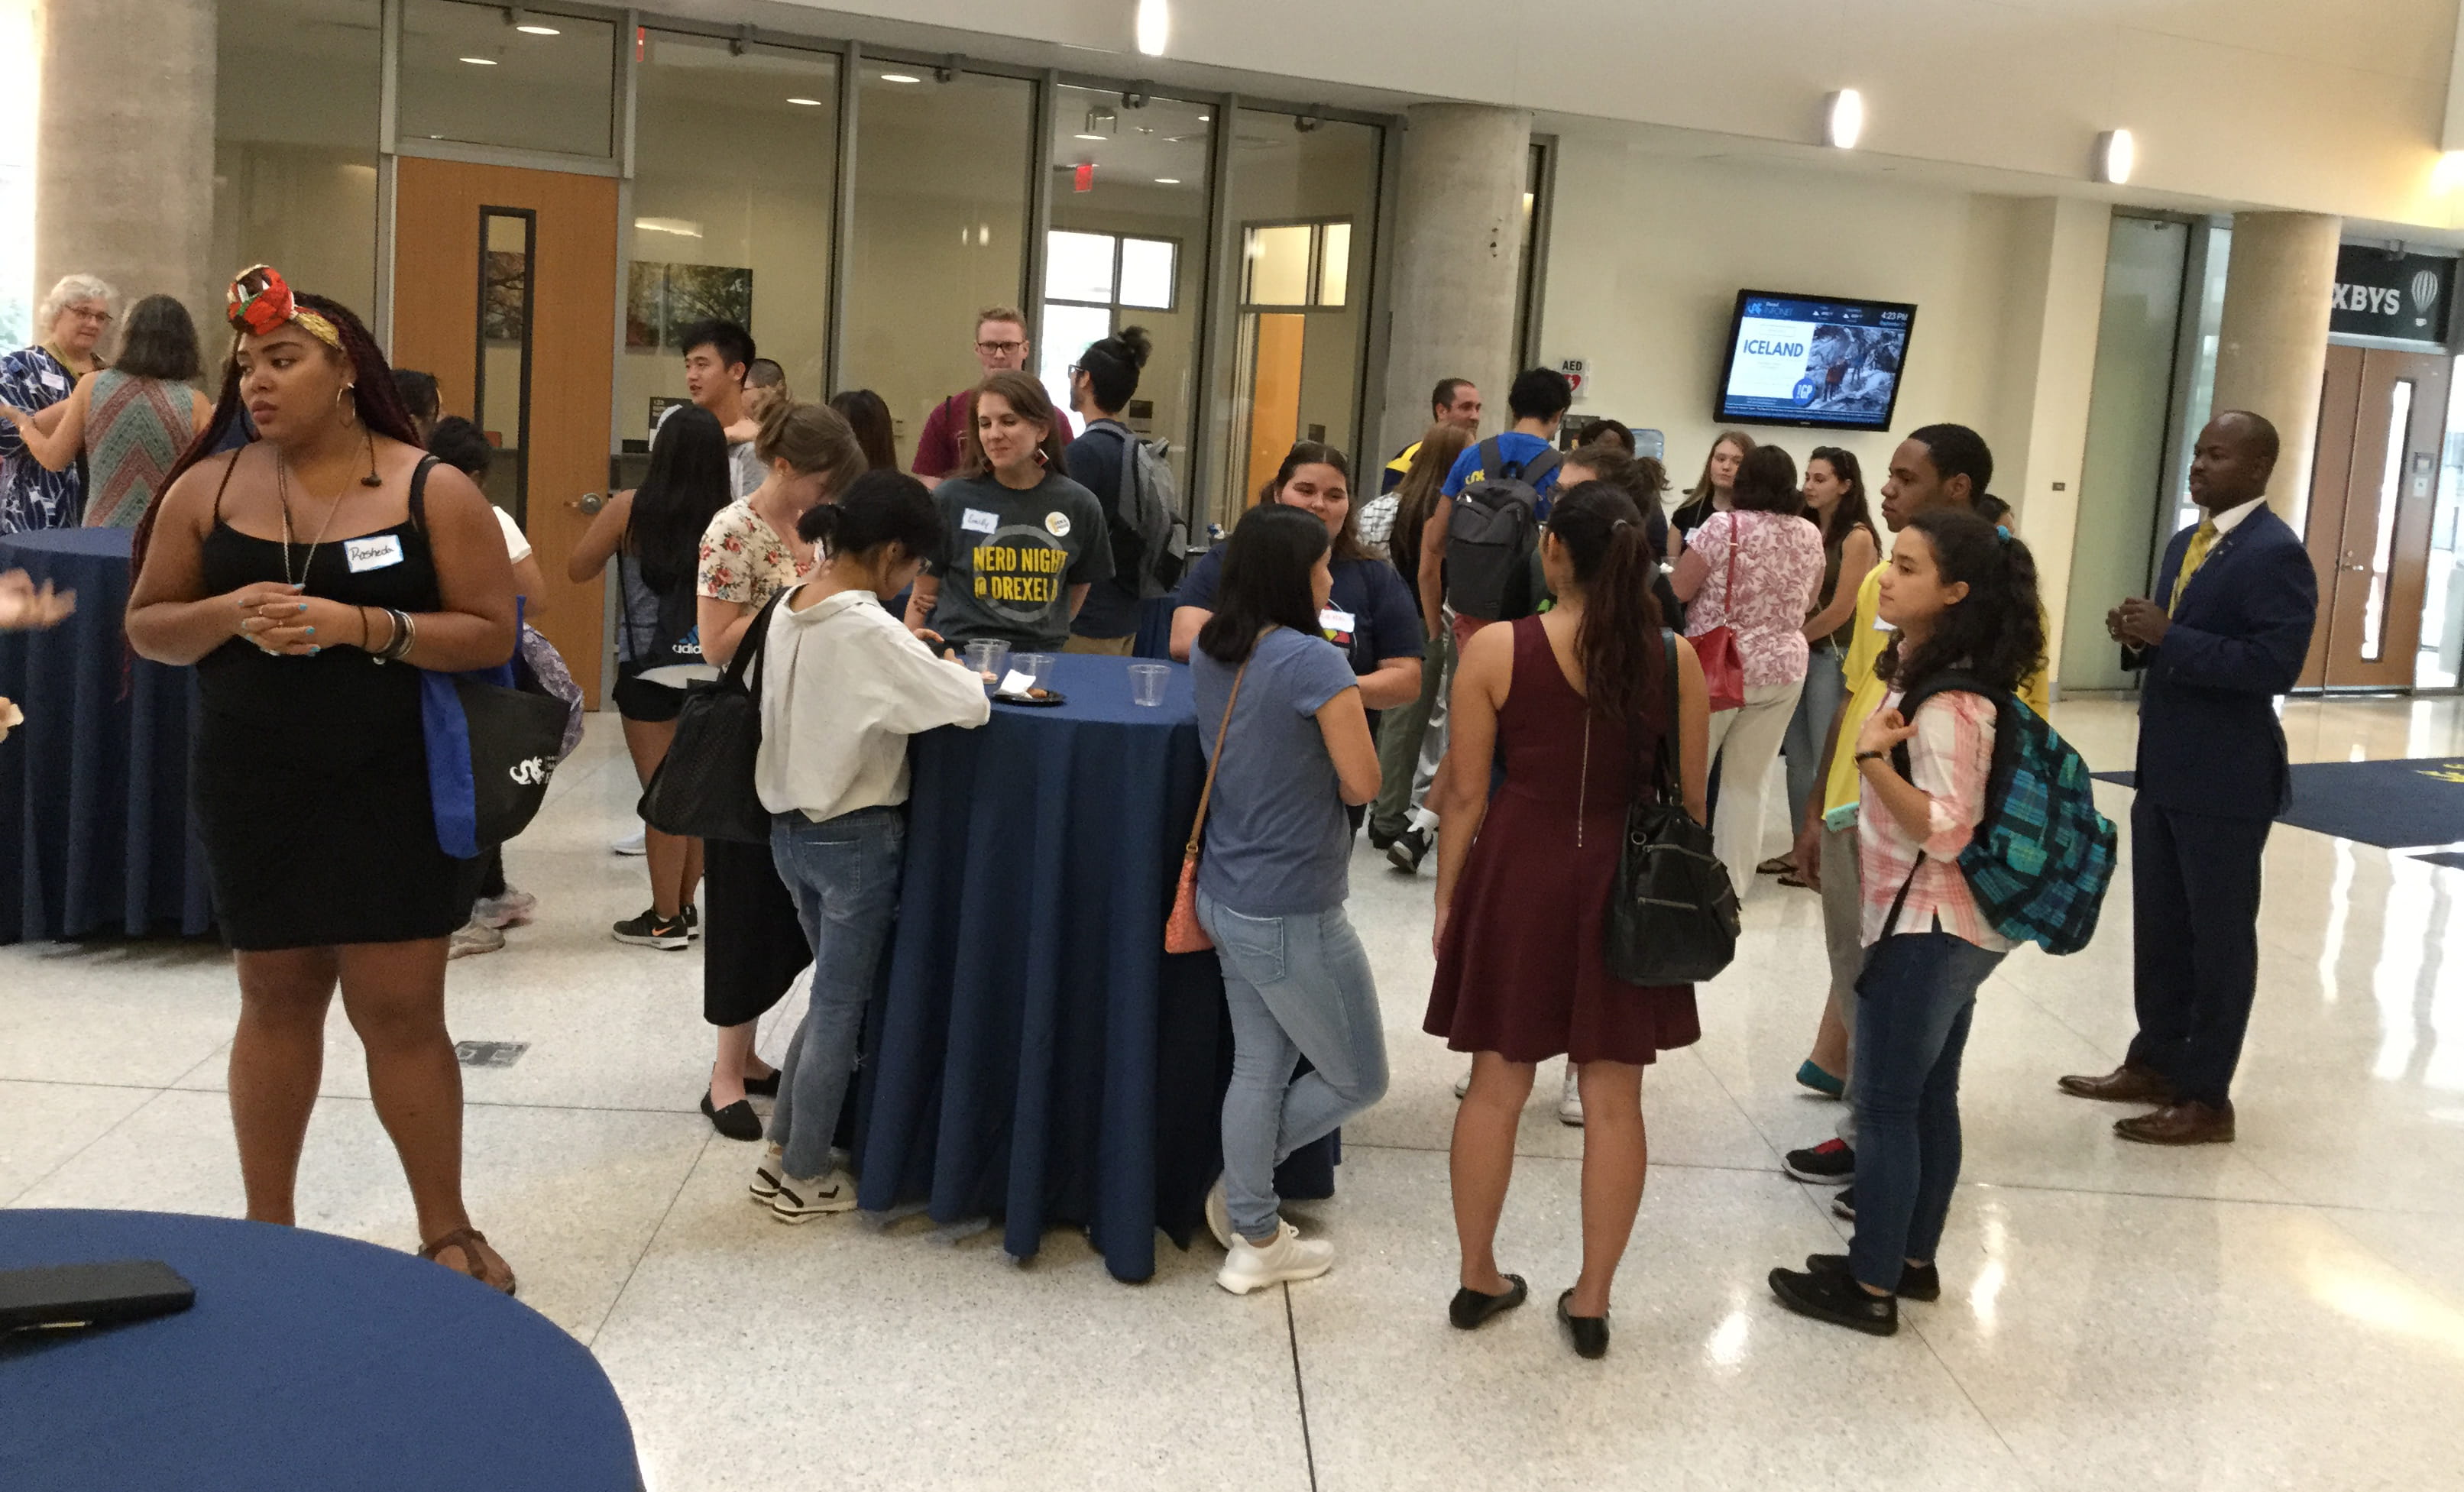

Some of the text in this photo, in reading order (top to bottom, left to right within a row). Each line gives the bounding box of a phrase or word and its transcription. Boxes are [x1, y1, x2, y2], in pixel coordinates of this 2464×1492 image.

[1881, 311, 1896, 320] 4:23
[1743, 339, 1804, 358] ICELAND
[1562, 361, 1582, 371] AED
[973, 546, 1068, 574] NERD NIGHT
